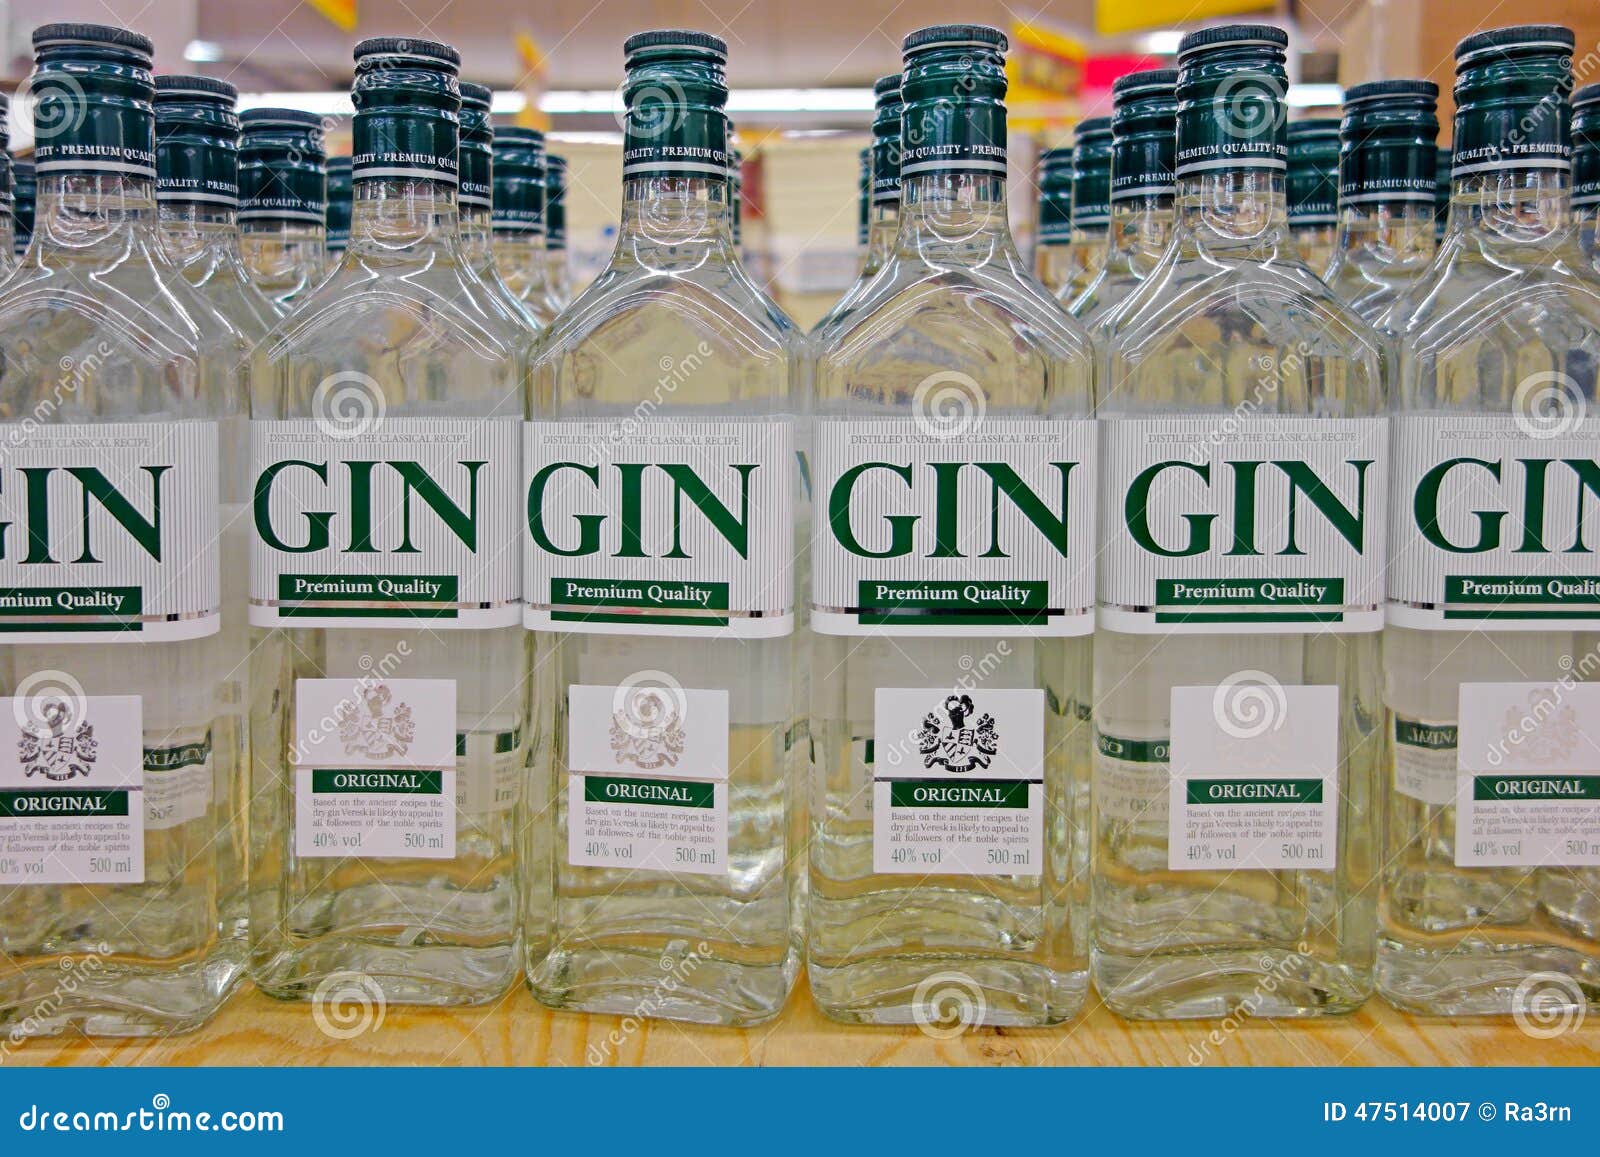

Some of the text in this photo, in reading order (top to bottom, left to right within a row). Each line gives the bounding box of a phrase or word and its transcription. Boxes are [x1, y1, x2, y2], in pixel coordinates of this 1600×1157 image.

[61, 144, 121, 156] PREMIUM
[662, 146, 711, 158] PREMIUM
[916, 144, 961, 159] QUALITY
[1222, 142, 1270, 155] QUALITY
[1512, 143, 1564, 154] PREMIUM
[383, 152, 436, 164] PREMIUM
[1363, 179, 1411, 190] PREMIUM
[263, 198, 302, 207] QUALITY
[359, 434, 377, 443] THE
[380, 434, 431, 443] CLASSICAL
[433, 434, 469, 443] RECIPE
[628, 436, 647, 445] THE
[650, 436, 702, 446] CLASSICAL
[705, 437, 741, 446] RECIPE
[851, 435, 903, 444] DISTILLED
[967, 434, 1021, 444] CLASSICAL
[1024, 434, 1060, 444] RECIPE
[1148, 434, 1200, 443] DISTILLED
[1243, 433, 1262, 442] THE
[1266, 433, 1319, 442] CLASSICAL
[1322, 432, 1356, 442] RECIPE
[254, 459, 489, 554] GIN
[527, 461, 760, 560] GIN
[829, 462, 1080, 559] GIN
[1125, 460, 1376, 557] GIN
[0, 466, 174, 563] IN
[295, 578, 442, 599] Premium Quality
[566, 582, 712, 604] Premium Quality
[876, 585, 1031, 605] Premium Quality
[1172, 582, 1327, 602] Premium Quality
[1461, 580, 1543, 596] Premium
[57, 591, 125, 610] Quality
[334, 774, 421, 788] ORIGINAL
[1495, 780, 1585, 794] ORIGINAL
[606, 783, 693, 801] ORIGINAL
[913, 788, 1006, 802] ORIGINAL
[1209, 783, 1301, 798] ORIGINAL
[14, 797, 107, 811] ORIGINAL
[585, 807, 608, 816] Based
[624, 808, 637, 817] the
[640, 810, 668, 819] ancient
[671, 812, 699, 822] recipes
[702, 814, 715, 822] the
[891, 812, 915, 821] Based
[933, 813, 946, 821] the
[950, 813, 979, 822] ancient
[1015, 814, 1029, 822] the
[1186, 809, 1211, 818] Based
[1228, 809, 1240, 817] the
[1244, 809, 1273, 817] ancient
[1277, 809, 1306, 819] recipes
[1309, 808, 1323, 817] the
[891, 823, 906, 833] dry
[950, 824, 957, 832] is
[958, 823, 981, 834] likely
[982, 824, 991, 833] to
[991, 824, 1019, 835] appeal
[1020, 825, 1029, 833] to
[313, 833, 444, 848] 40% vol 500 ml
[905, 834, 942, 843] followers
[946, 835, 955, 843] of
[958, 835, 972, 843] the
[585, 841, 715, 864] 40% vol 500 ml
[1186, 844, 1323, 860] 40% vol 500 ml
[1472, 840, 1498, 856] 40%
[1502, 841, 1521, 856] vol
[1566, 840, 1587, 855] 500
[891, 848, 1030, 865] 40% vol 500 ml
[24, 858, 44, 873] vol
[90, 858, 111, 872] 500
[115, 857, 131, 872] ml
